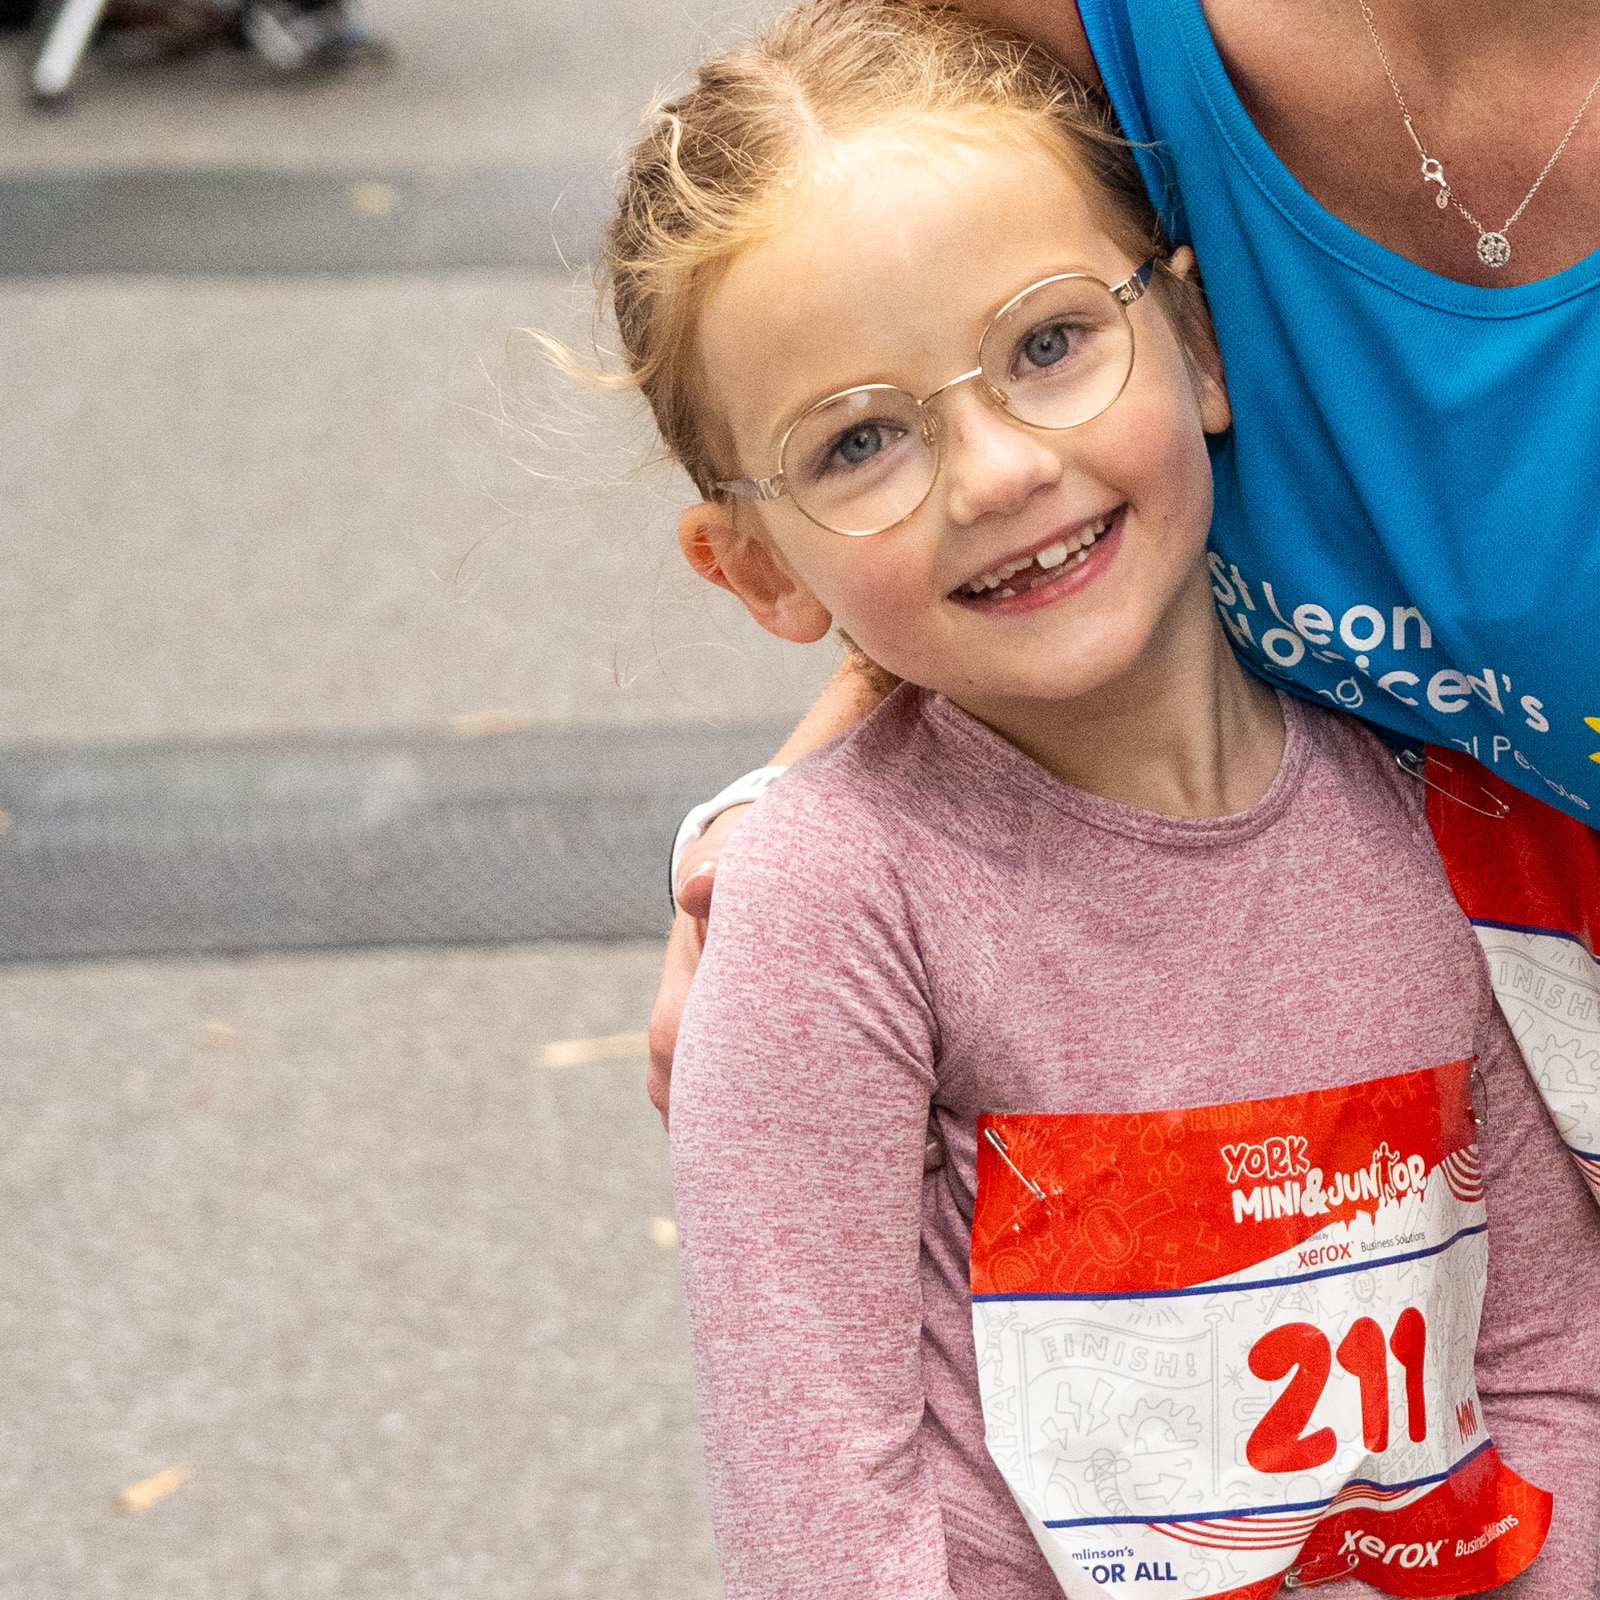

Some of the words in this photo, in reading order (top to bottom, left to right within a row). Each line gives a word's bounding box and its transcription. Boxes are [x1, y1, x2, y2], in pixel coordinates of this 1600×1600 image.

[1207, 551, 1256, 611] St
[1221, 1136, 1310, 1184] YORK
[1297, 1241, 1352, 1269] xerox
[1361, 1238, 1394, 1252] Business
[1395, 1231, 1426, 1245] Solutions
[1041, 1333, 1197, 1378] FINISH!
[1246, 1306, 1427, 1473] 211
[1072, 1545, 1134, 1560] mlinson's
[1337, 1529, 1444, 1569] xerox
[1083, 1563, 1126, 1584] OR
[1134, 1561, 1178, 1582] ALL
